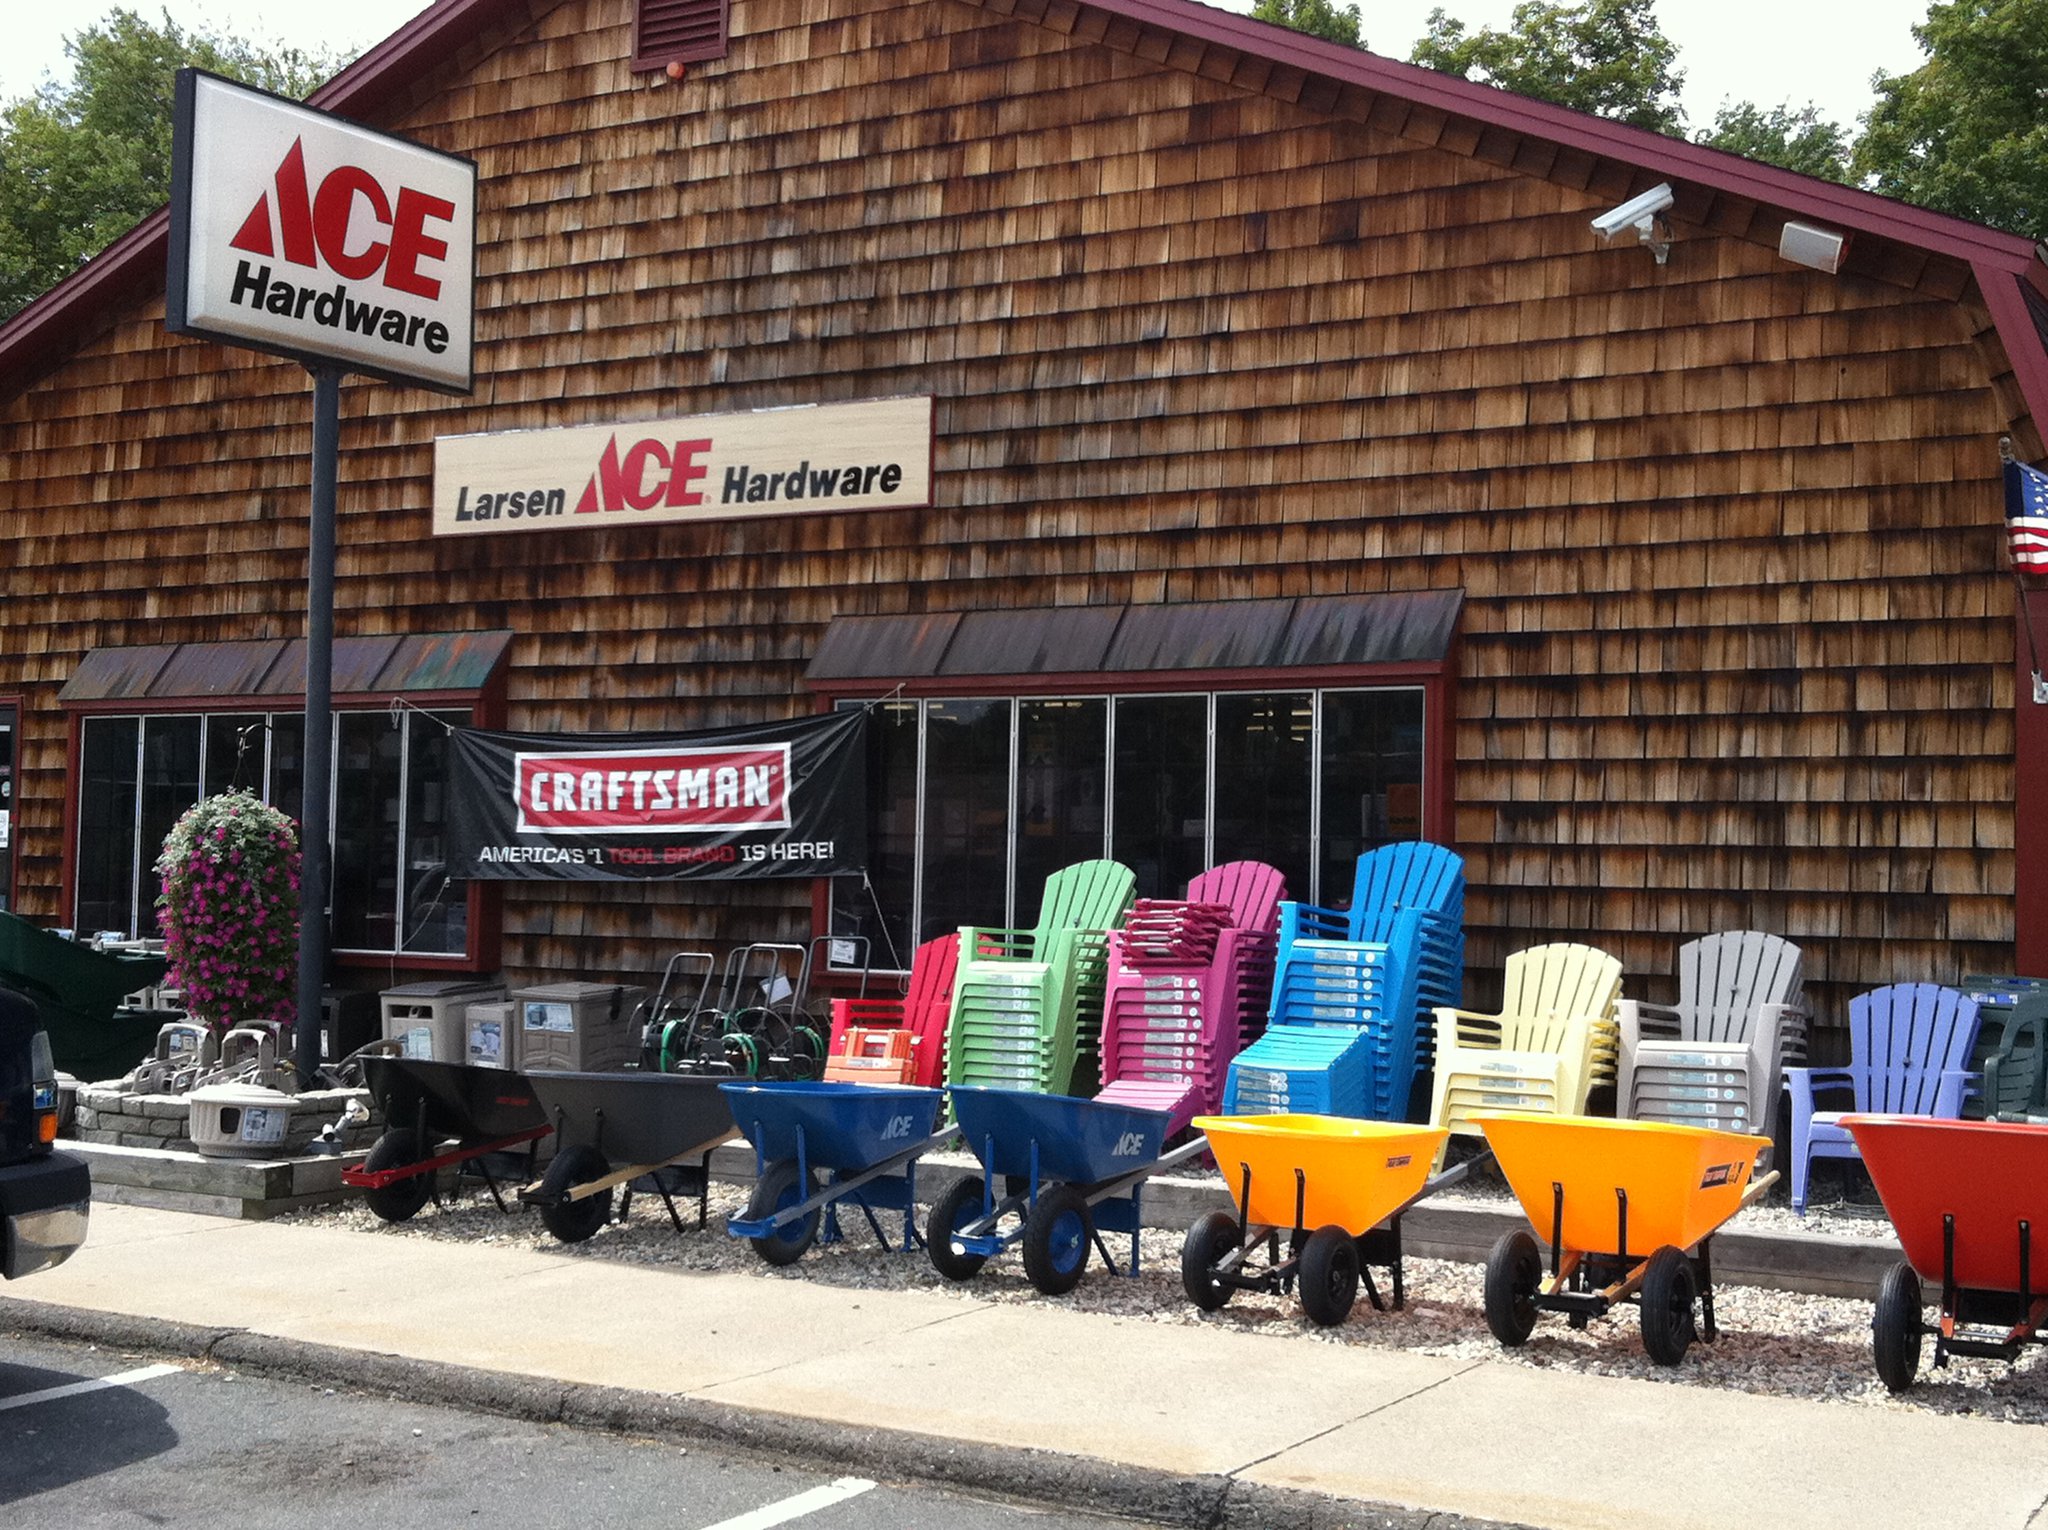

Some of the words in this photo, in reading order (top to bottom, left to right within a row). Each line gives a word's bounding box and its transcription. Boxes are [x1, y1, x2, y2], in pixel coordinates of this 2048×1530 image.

[229, 134, 455, 301] ACE
[230, 260, 449, 354] Hardware
[455, 486, 566, 522] Larsen
[574, 432, 713, 514] ACE
[721, 461, 903, 504] Hardware
[530, 765, 771, 812] CRAFTSMAN
[478, 846, 585, 864] AMERICA'S
[608, 847, 660, 864] TOOL
[664, 845, 736, 863] BRAND
[740, 844, 767, 861] IS
[771, 841, 835, 860] HERE!
[880, 1115, 913, 1140] ACE
[1111, 1131, 1144, 1156] ACE
